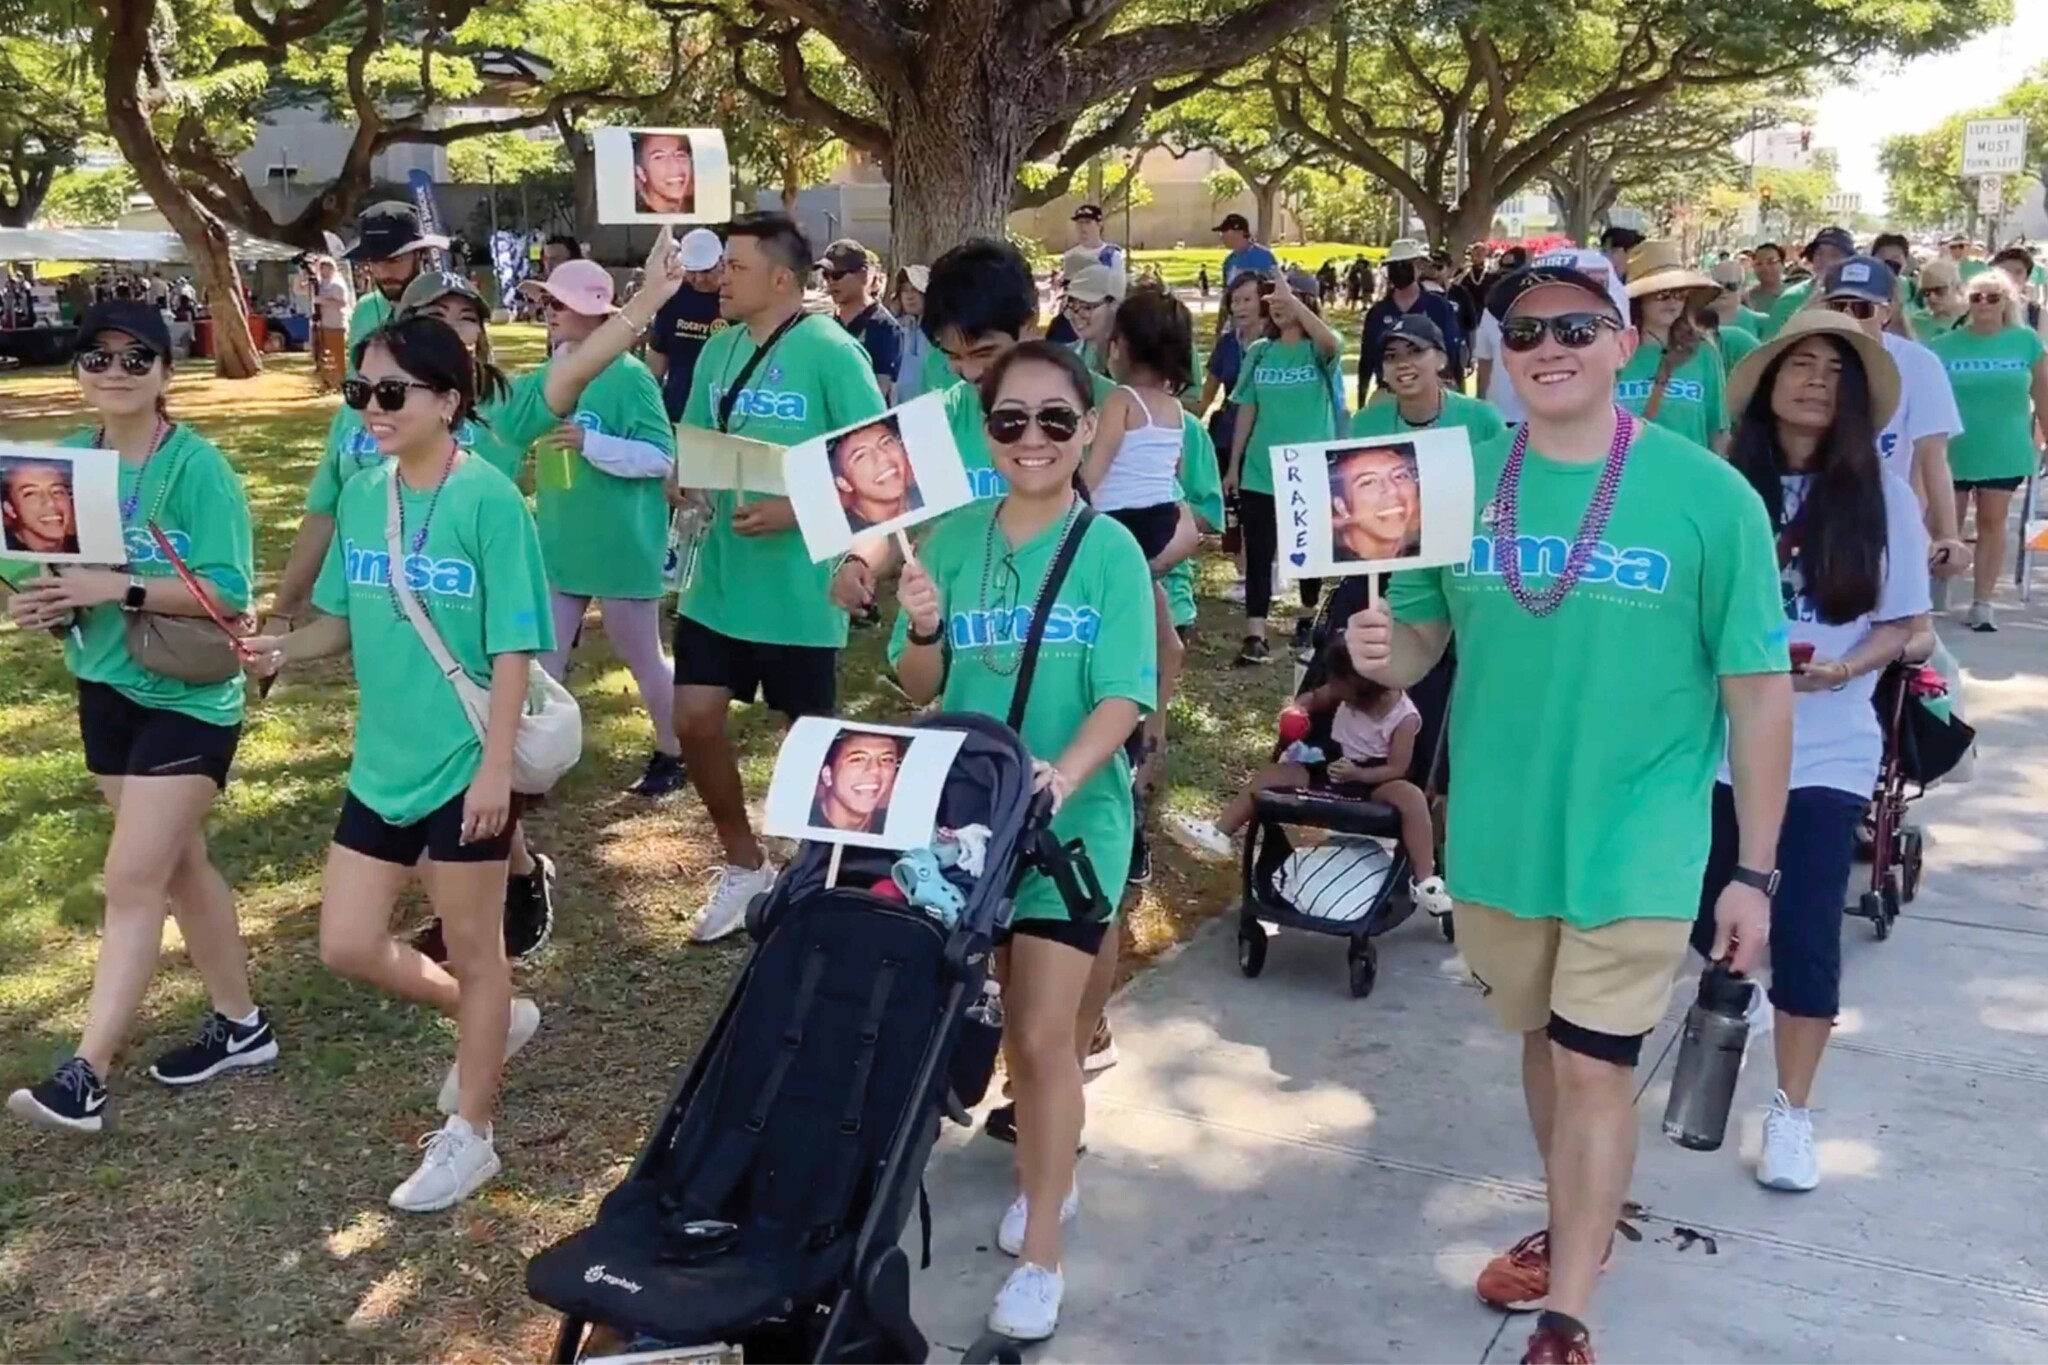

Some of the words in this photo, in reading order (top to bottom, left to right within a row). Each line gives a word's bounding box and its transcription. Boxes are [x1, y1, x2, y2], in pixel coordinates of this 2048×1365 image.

[1978, 139, 2010, 152] MUST
[676, 318, 709, 334] Rotary
[1283, 448, 1308, 548] DRAKE
